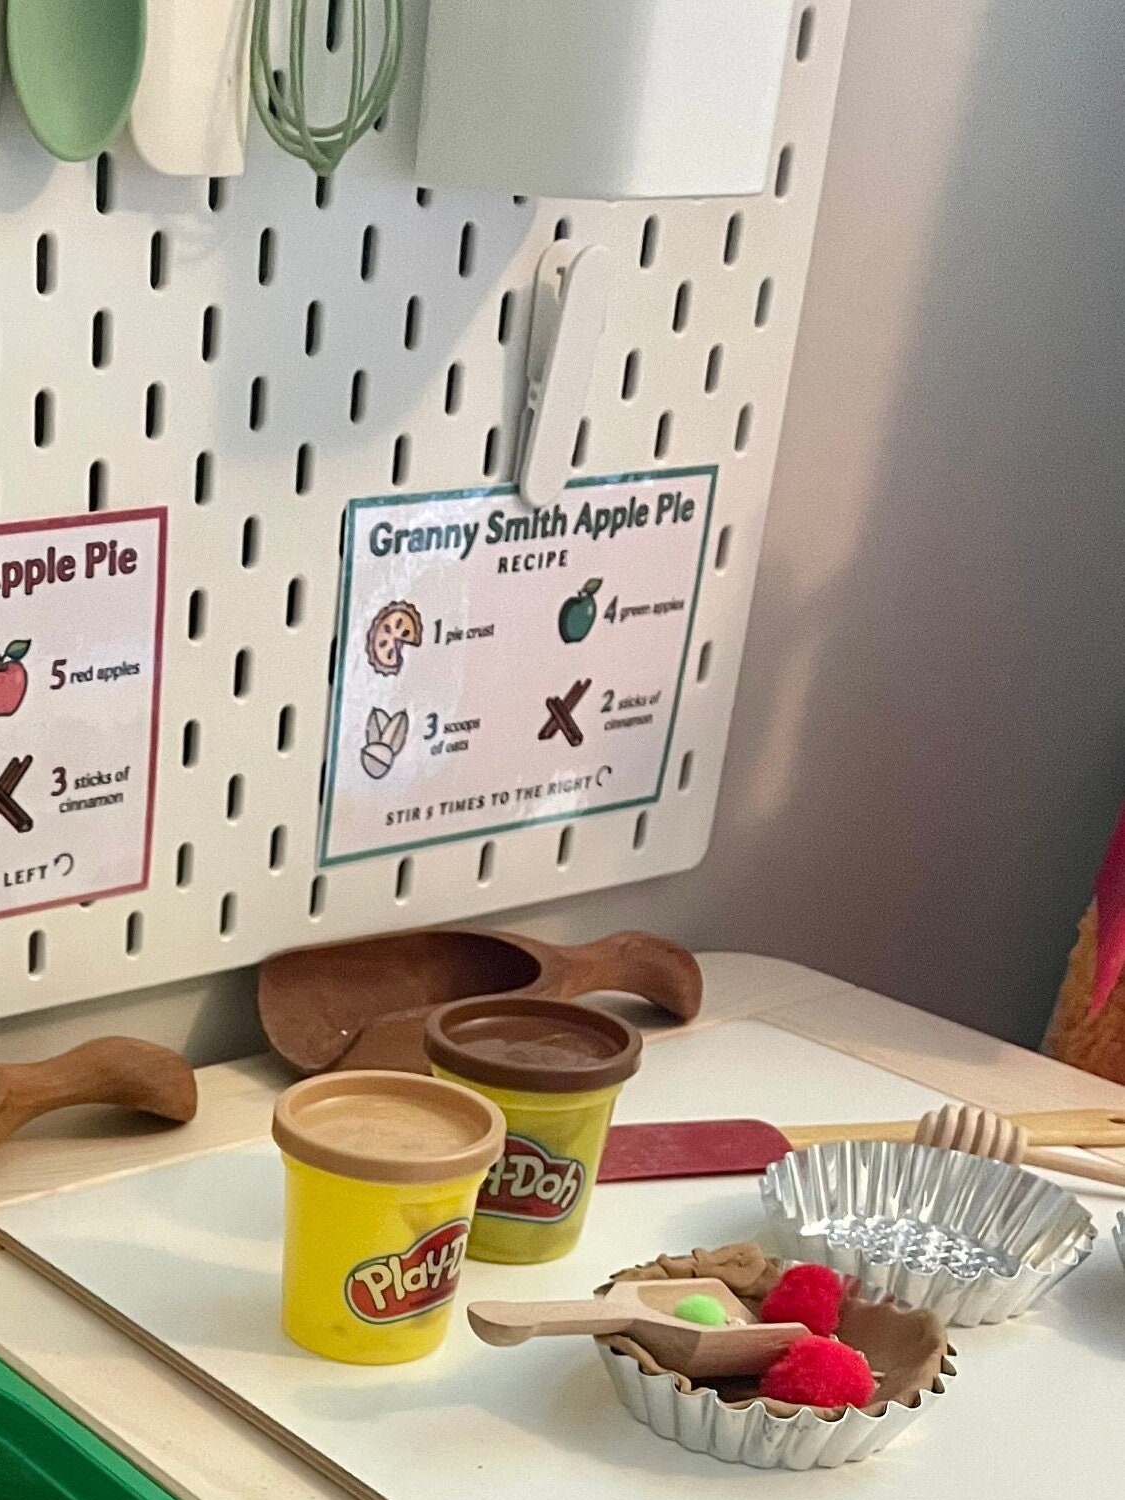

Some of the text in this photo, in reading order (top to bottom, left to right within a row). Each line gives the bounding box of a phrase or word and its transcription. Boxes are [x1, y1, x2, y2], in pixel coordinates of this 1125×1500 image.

[369, 491, 695, 561] Granny Smith Apple Pie
[85, 539, 138, 579] Pie
[497, 549, 568, 574] RECIPE
[603, 595, 685, 624] 4 green apples
[434, 619, 495, 645] 1 pie crust
[49, 658, 140, 690] 5 red apples
[600, 689, 661, 714] 2 sticks of
[423, 712, 481, 740] 3 scoops
[604, 714, 653, 731] cinnamon
[431, 740, 469, 755] of oats
[50, 765, 131, 797] 3 sticks of
[59, 792, 123, 813] cinnamon
[385, 776, 592, 826] STIR 5 TIMES TO THE RIGHT
[4, 864, 48, 887] LEFT
